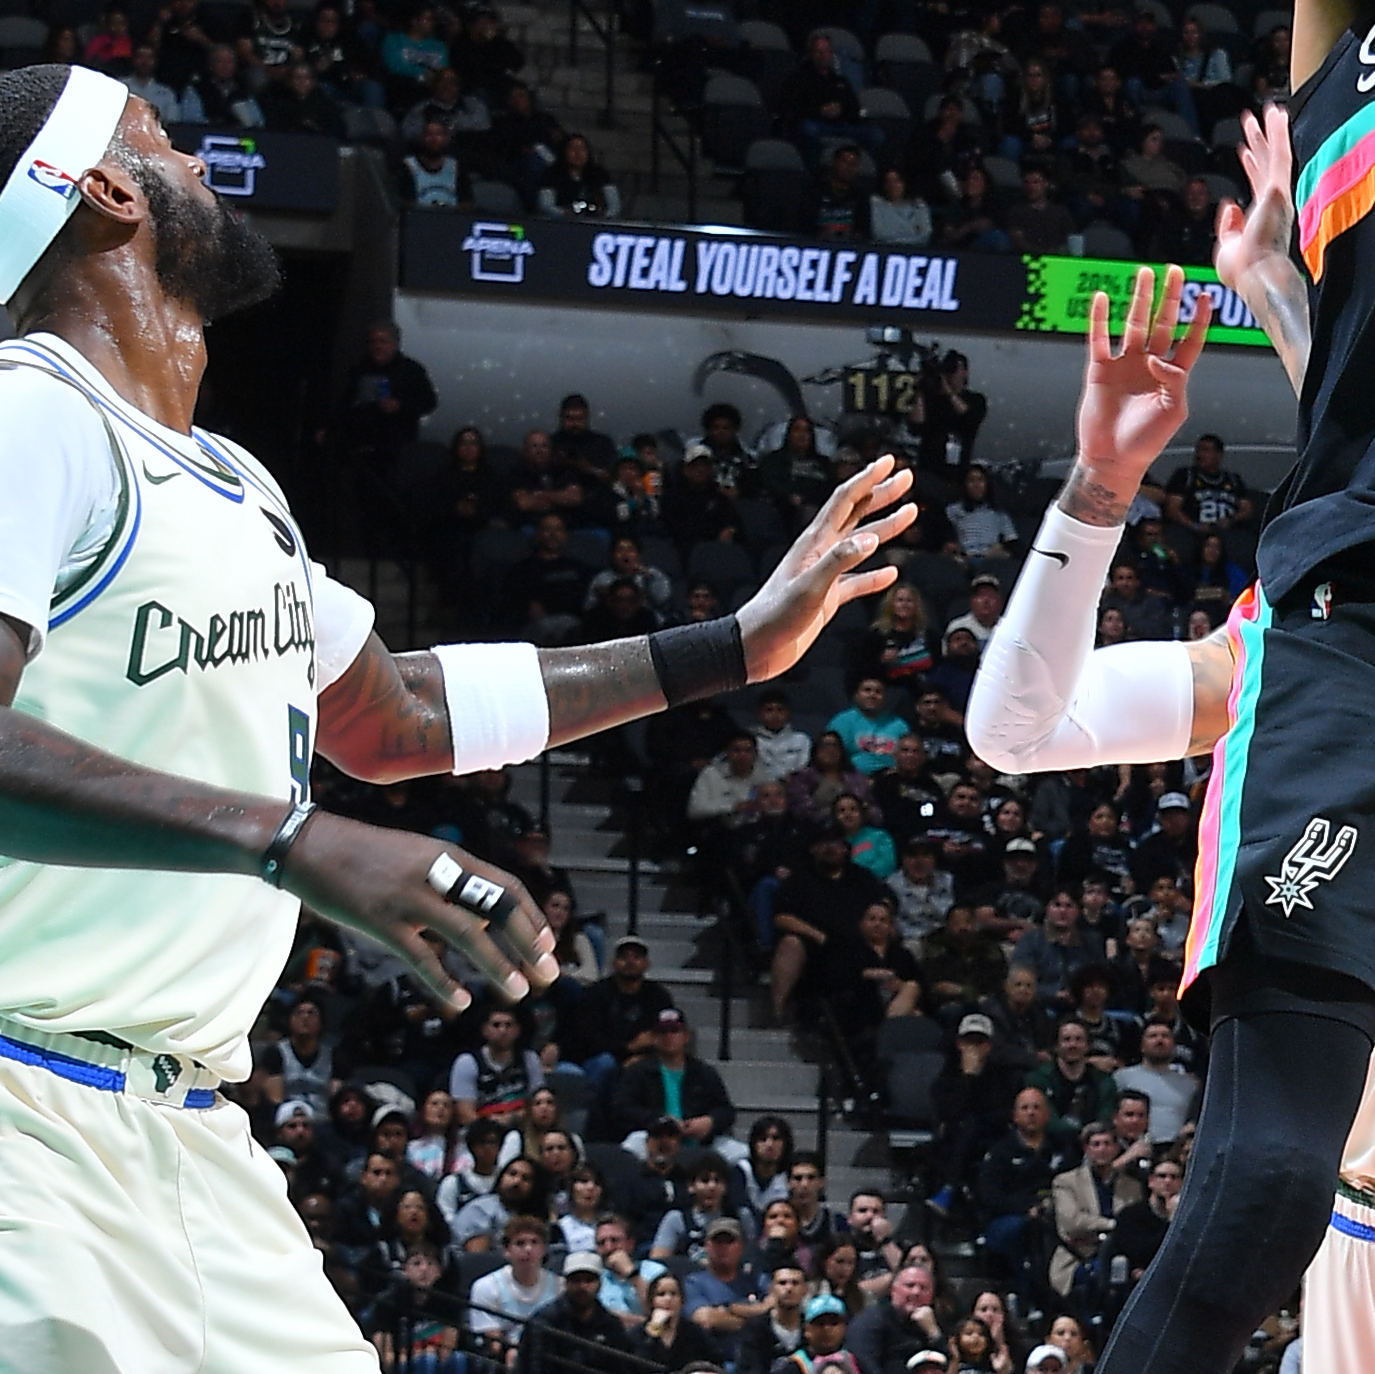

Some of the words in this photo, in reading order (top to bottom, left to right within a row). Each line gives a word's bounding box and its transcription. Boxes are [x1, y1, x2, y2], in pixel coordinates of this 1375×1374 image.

[587, 231, 688, 293] STEAL
[694, 240, 857, 304] YOURSELF
[852, 252, 879, 306] A
[880, 254, 961, 312] DEAL
[847, 372, 916, 413] 112
[126, 600, 270, 688] Cream
[273, 580, 316, 691] City
